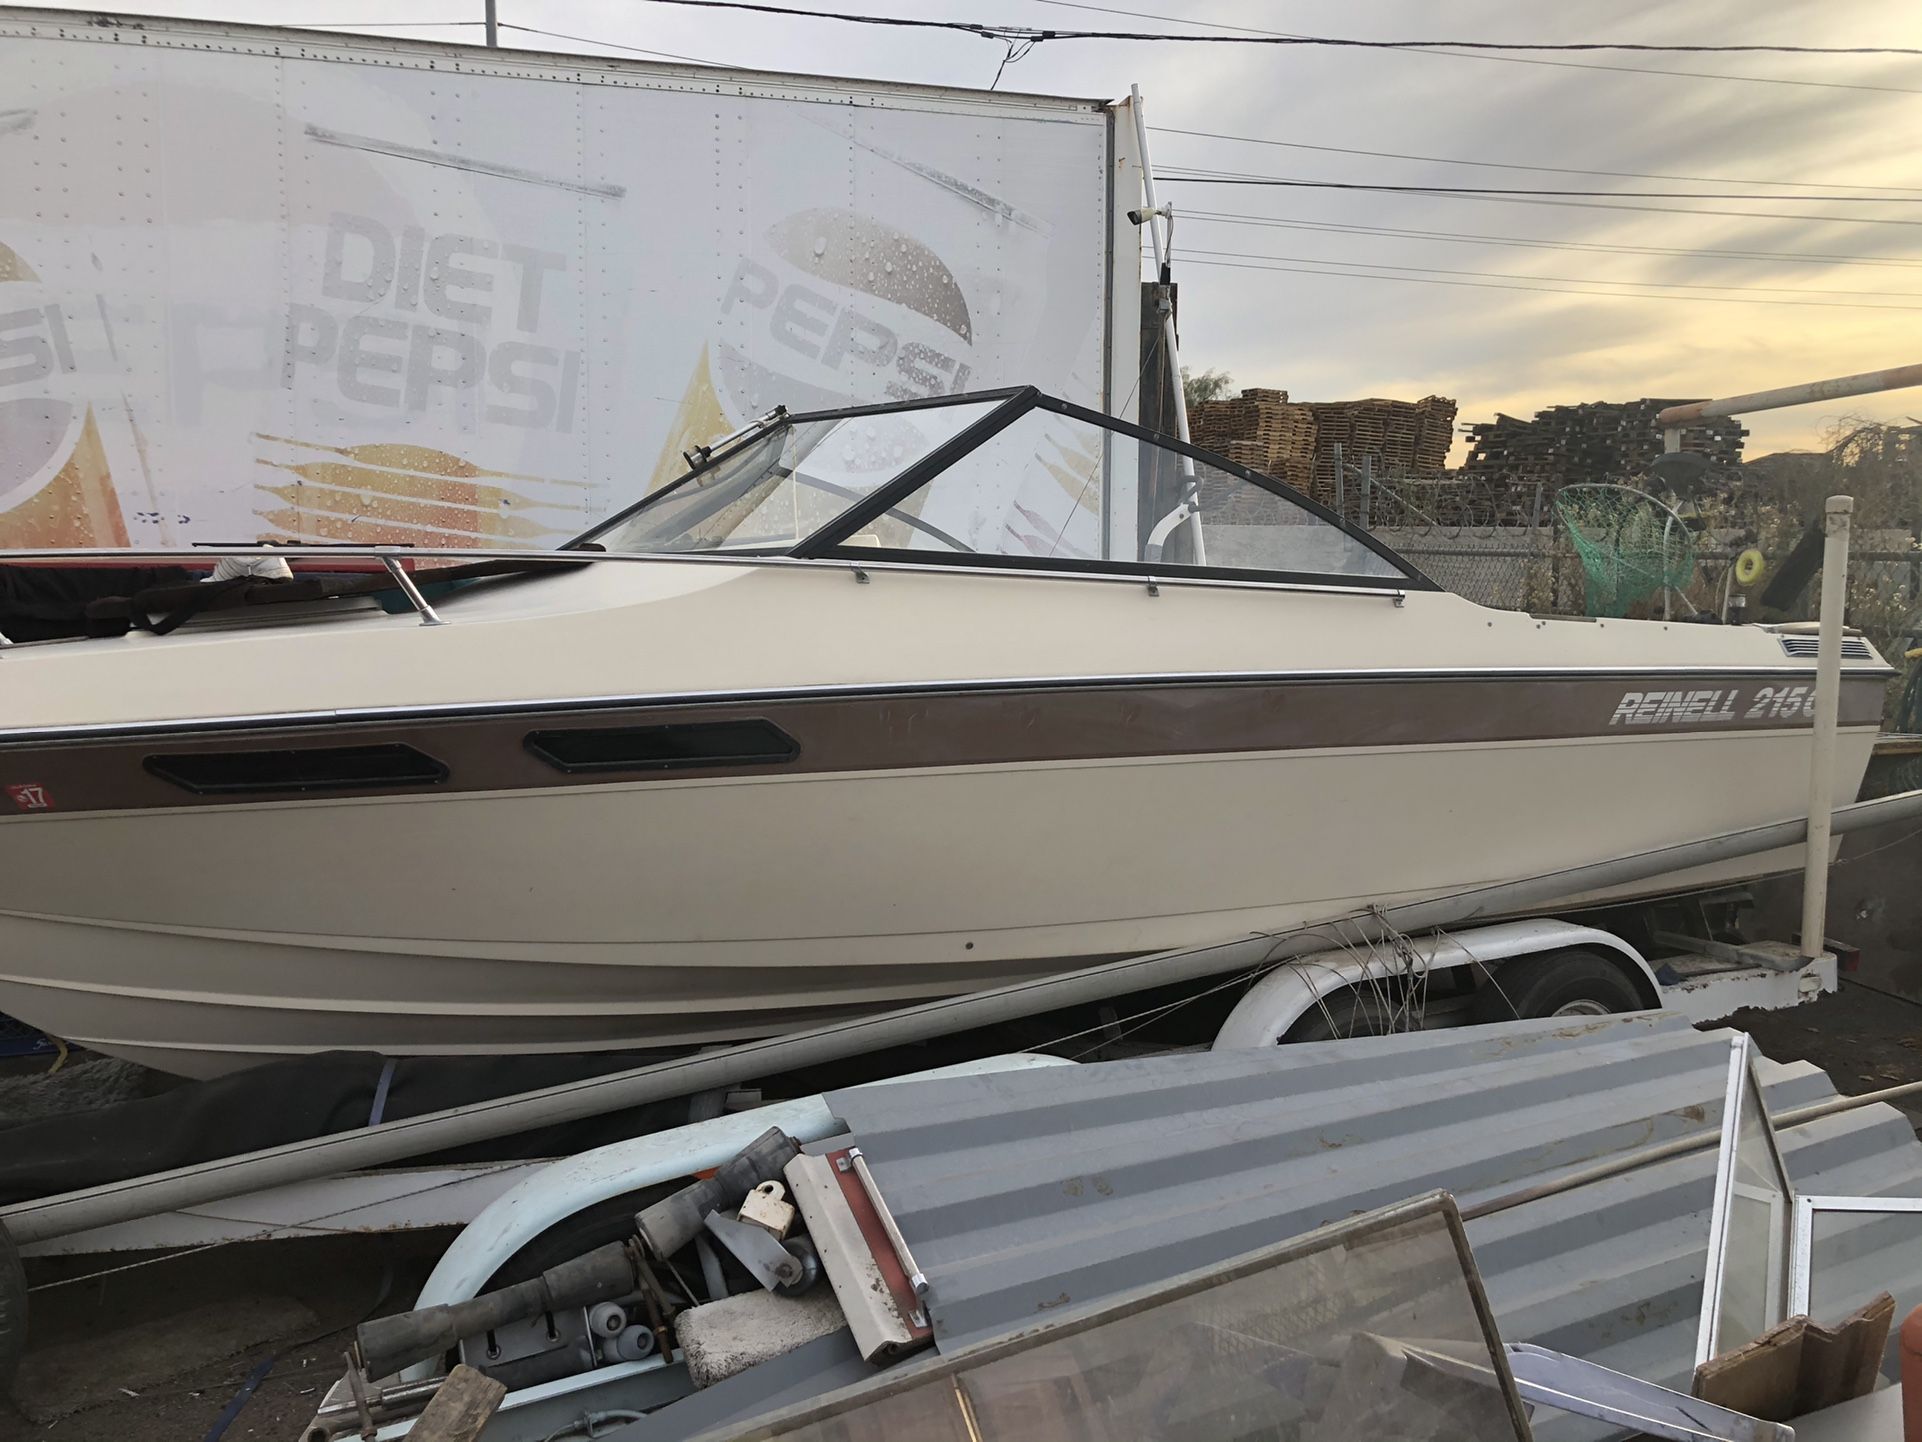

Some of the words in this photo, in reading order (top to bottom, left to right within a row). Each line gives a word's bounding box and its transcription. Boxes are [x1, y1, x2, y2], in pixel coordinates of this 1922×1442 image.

[321, 211, 567, 333] DIET
[720, 256, 972, 402] PEPSI
[281, 303, 580, 434] PEPSI
[1609, 690, 1738, 725] REINELL
